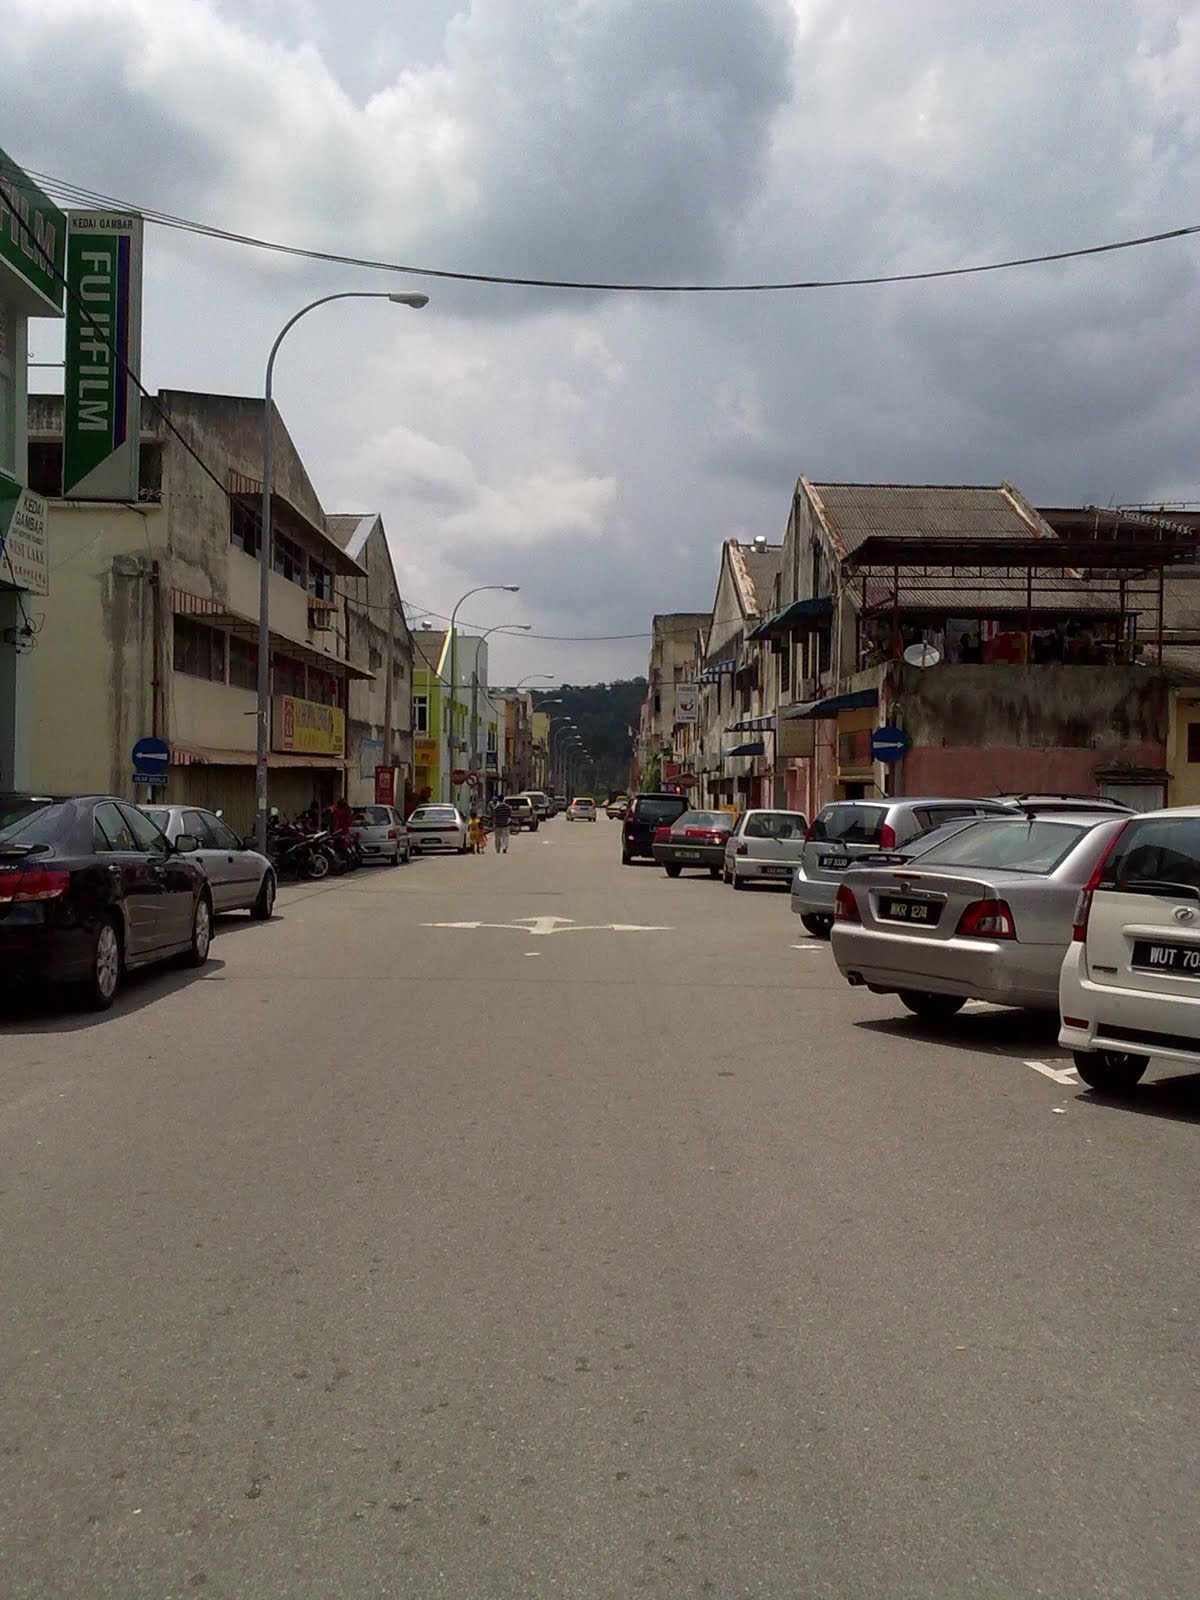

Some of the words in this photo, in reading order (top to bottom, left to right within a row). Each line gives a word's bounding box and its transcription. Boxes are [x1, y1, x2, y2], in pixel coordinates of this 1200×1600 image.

[72, 219, 97, 229] KEDAI
[99, 219, 133, 230] GAMBAR
[78, 251, 112, 431] FUJIFILM
[23, 496, 45, 518] KEDAI
[15, 511, 44, 536] GAMBAR
[1149, 947, 1177, 965] WUT
[1183, 951, 1200, 968] 70
